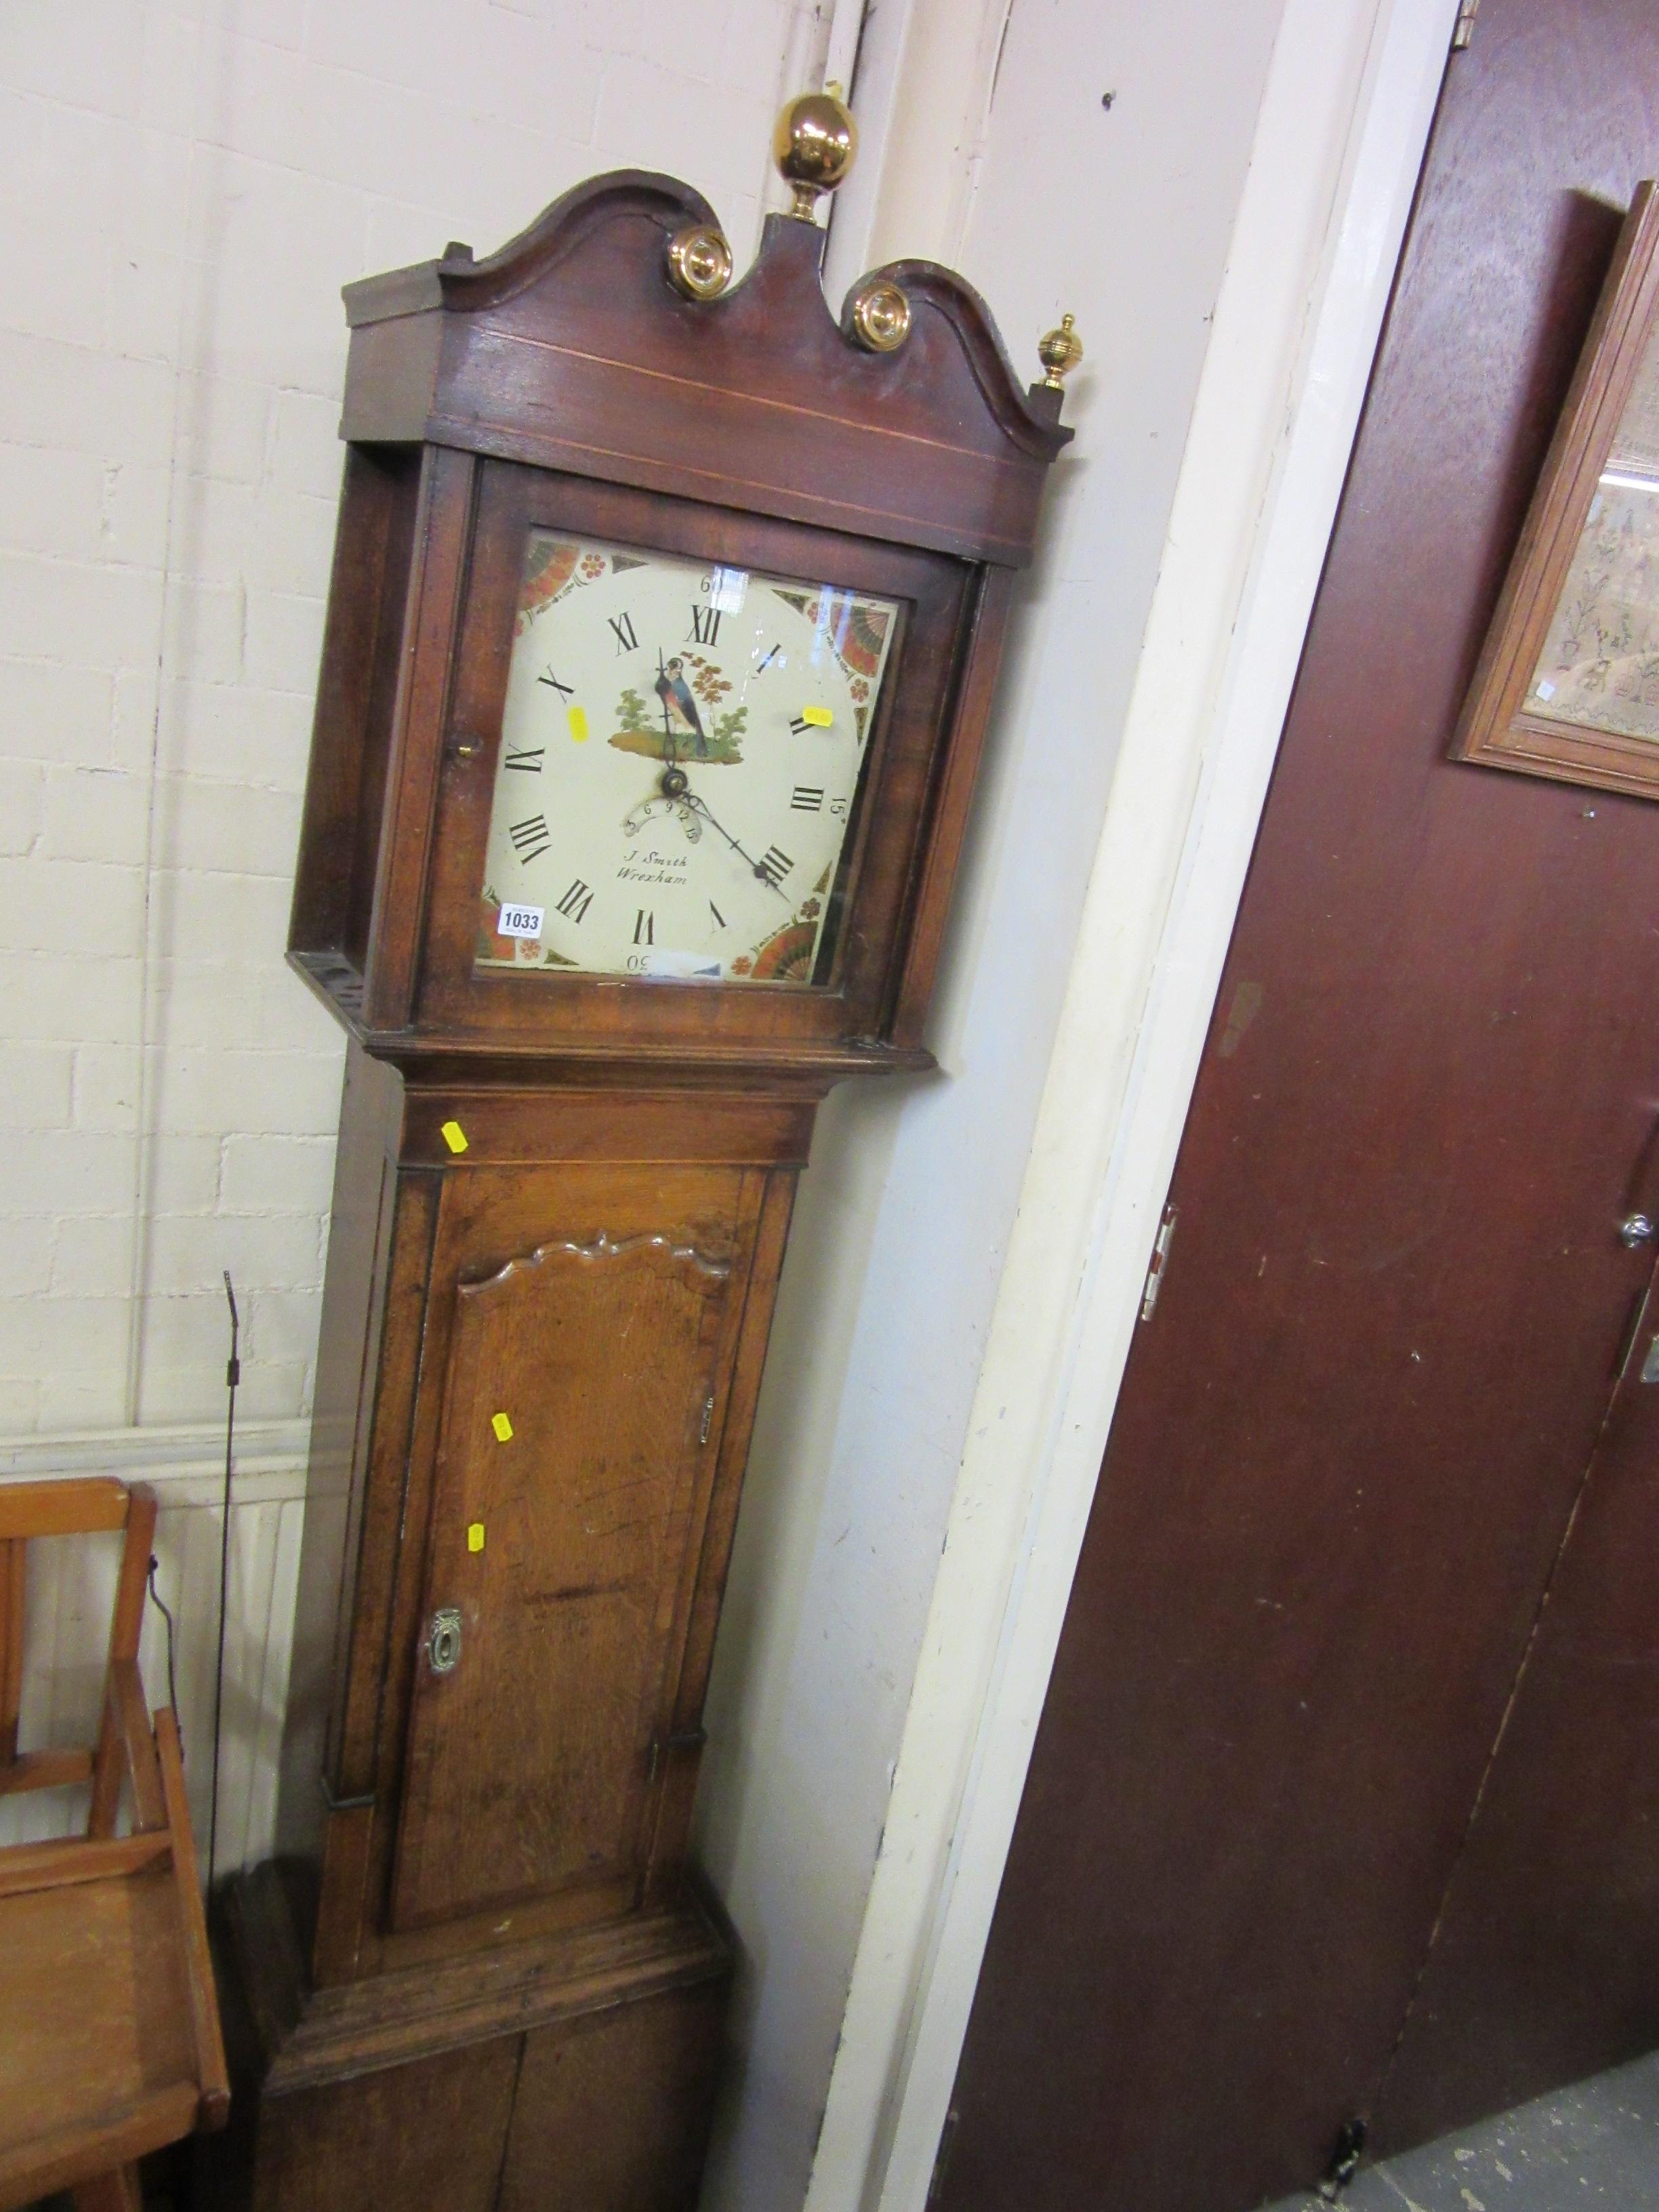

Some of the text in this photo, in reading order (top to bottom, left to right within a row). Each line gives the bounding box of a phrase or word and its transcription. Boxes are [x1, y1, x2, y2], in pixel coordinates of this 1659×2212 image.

[607, 611, 640, 656] XI
[684, 605, 722, 647] XII
[537, 663, 575, 703] X
[505, 743, 545, 773] IX
[790, 785, 825, 812] III
[644, 804, 651, 815] 6
[665, 800, 673, 813] 9
[676, 809, 689, 822] 12
[686, 827, 697, 840] 15
[509, 815, 552, 865] VIII
[616, 867, 687, 885] Wrexham
[642, 851, 687, 867] Smith
[554, 878, 594, 924] VII
[710, 899, 726, 934] V
[506, 912, 539, 930] 1033
[632, 909, 655, 945] VI
